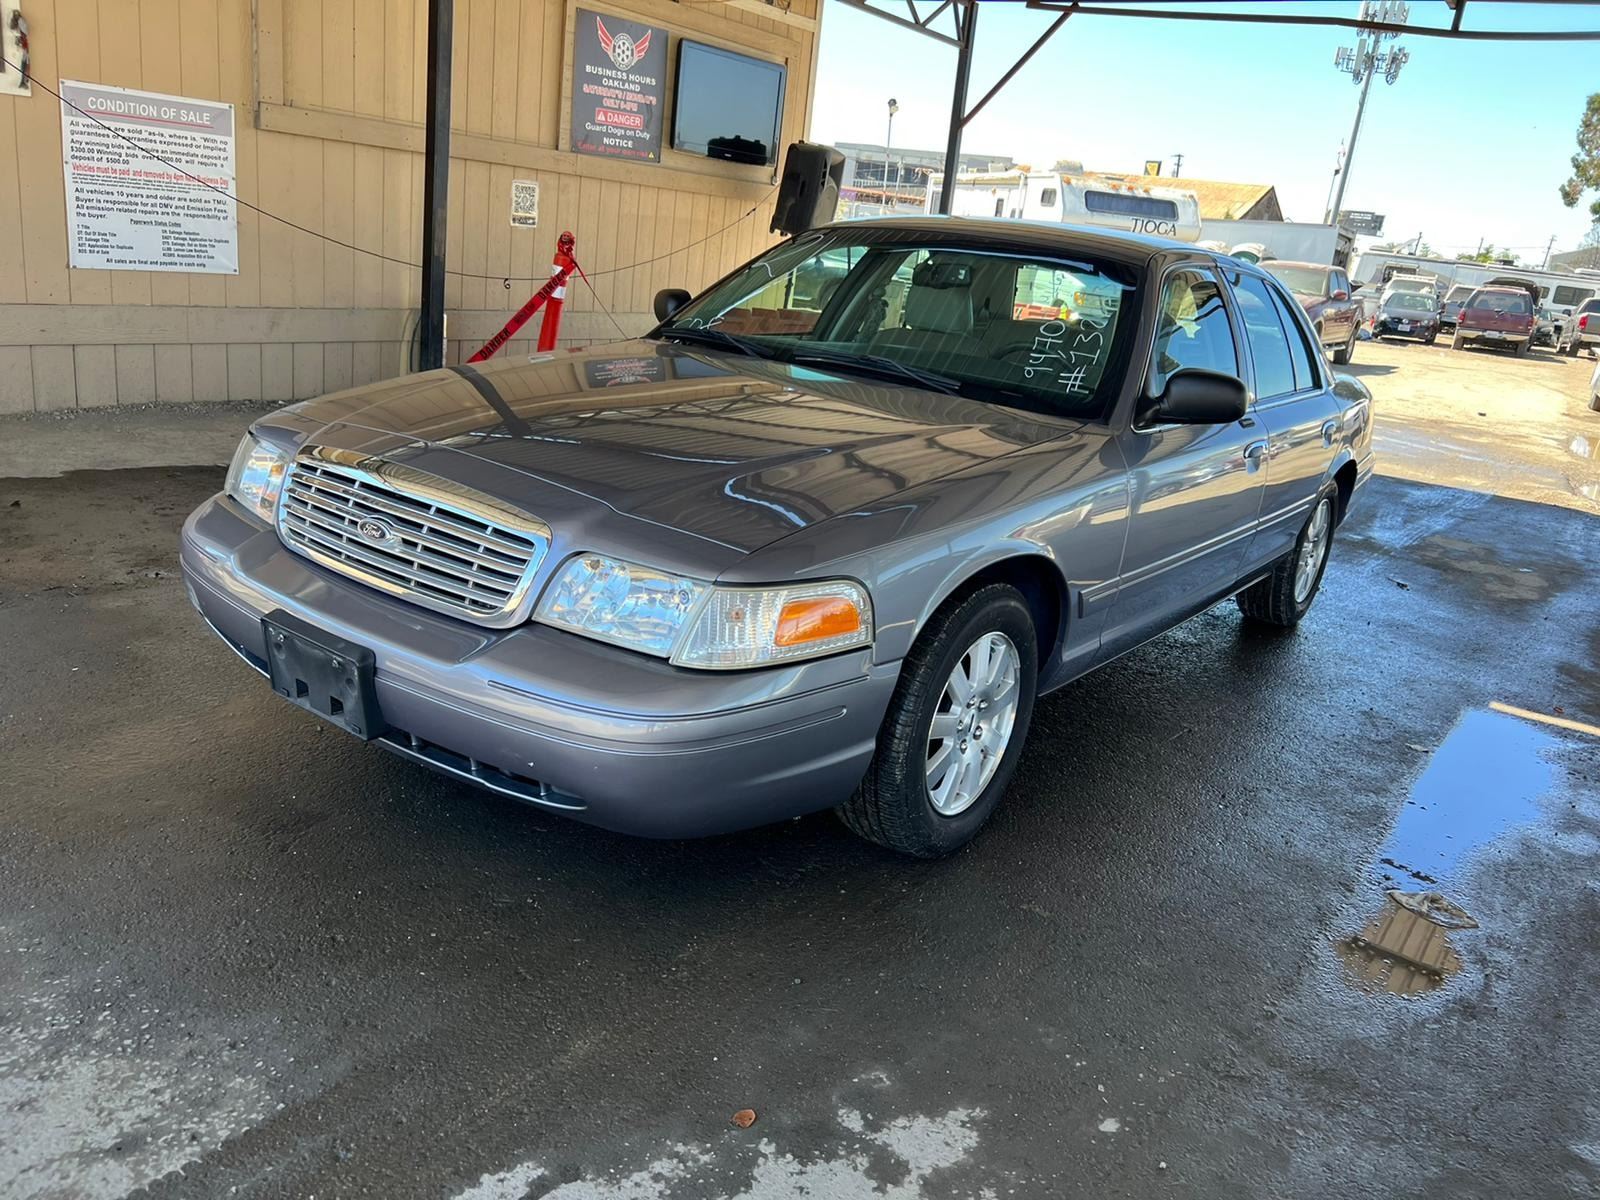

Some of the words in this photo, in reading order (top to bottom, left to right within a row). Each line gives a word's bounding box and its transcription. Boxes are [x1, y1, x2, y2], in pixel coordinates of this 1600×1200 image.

[586, 64, 627, 80] BUSINESS
[629, 73, 656, 86] HOURS
[602, 78, 640, 92] OAKLAND
[87, 96, 157, 117] CONDITION
[160, 106, 176, 119] OF
[179, 109, 210, 124] SALE
[607, 113, 640, 126] DANGER
[69, 128, 110, 139] guarantees
[158, 139, 193, 149] expressed
[168, 132, 188, 140] where
[585, 122, 606, 132] Guard
[608, 126, 624, 136] Dogs
[636, 130, 650, 140] Duty
[85, 140, 109, 149] winning
[169, 149, 198, 157] immediate
[200, 153, 221, 161] deposit
[603, 137, 633, 148] NOTICE
[70, 145, 95, 154] $300.00
[96, 148, 122, 157] Winning
[197, 159, 217, 167] require
[70, 153, 95, 162] deposit
[106, 156, 129, 165] $500.00
[72, 162, 95, 172] Vehicles
[96, 165, 109, 173] must
[118, 167, 130, 177] paid
[132, 168, 142, 177] and
[143, 170, 164, 179] removed
[173, 172, 183, 182] 4pm
[75, 195, 94, 204] Buyer
[102, 198, 139, 207] responsible
[186, 204, 212, 212] Emission
[129, 218, 153, 226] Paperwork
[138, 208, 159, 216] repairs
[183, 212, 220, 220] responsibility
[1131, 218, 1177, 237] TIOGA
[538, 268, 567, 301] DANGER
[480, 327, 510, 361] DANGER
[1024, 320, 1066, 378] 9470
[363, 522, 382, 538] Ford
